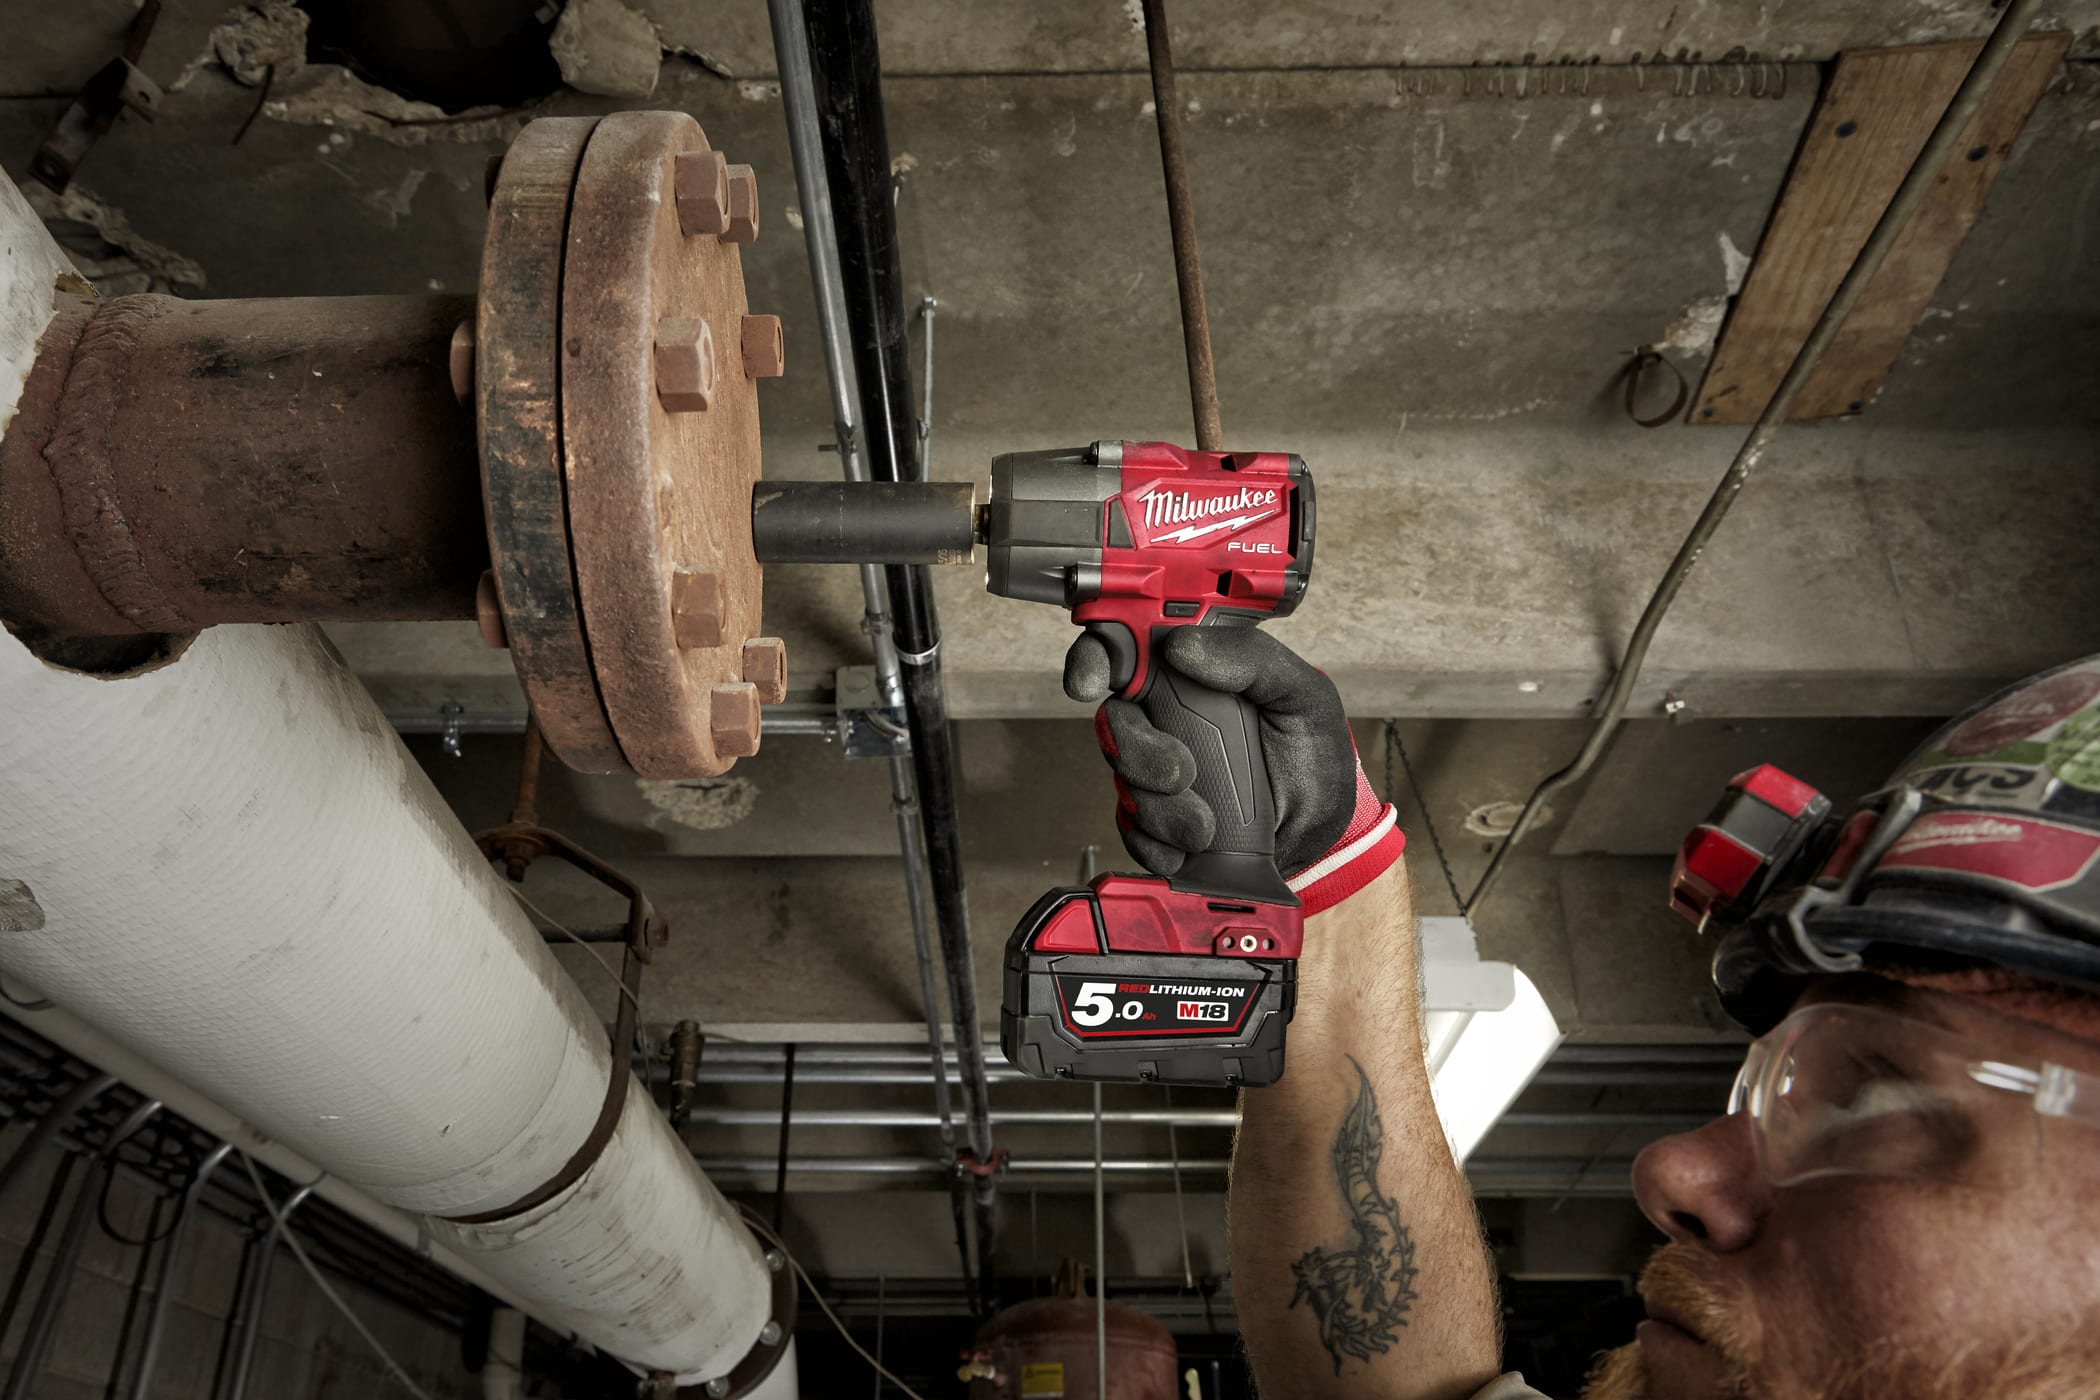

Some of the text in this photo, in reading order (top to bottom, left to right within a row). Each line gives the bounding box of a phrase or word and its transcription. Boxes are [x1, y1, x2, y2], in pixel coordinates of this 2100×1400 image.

[1138, 487, 1278, 530] Milwaukee
[1227, 541, 1283, 554] FUEL
[1179, 1002, 1226, 1019] M18
